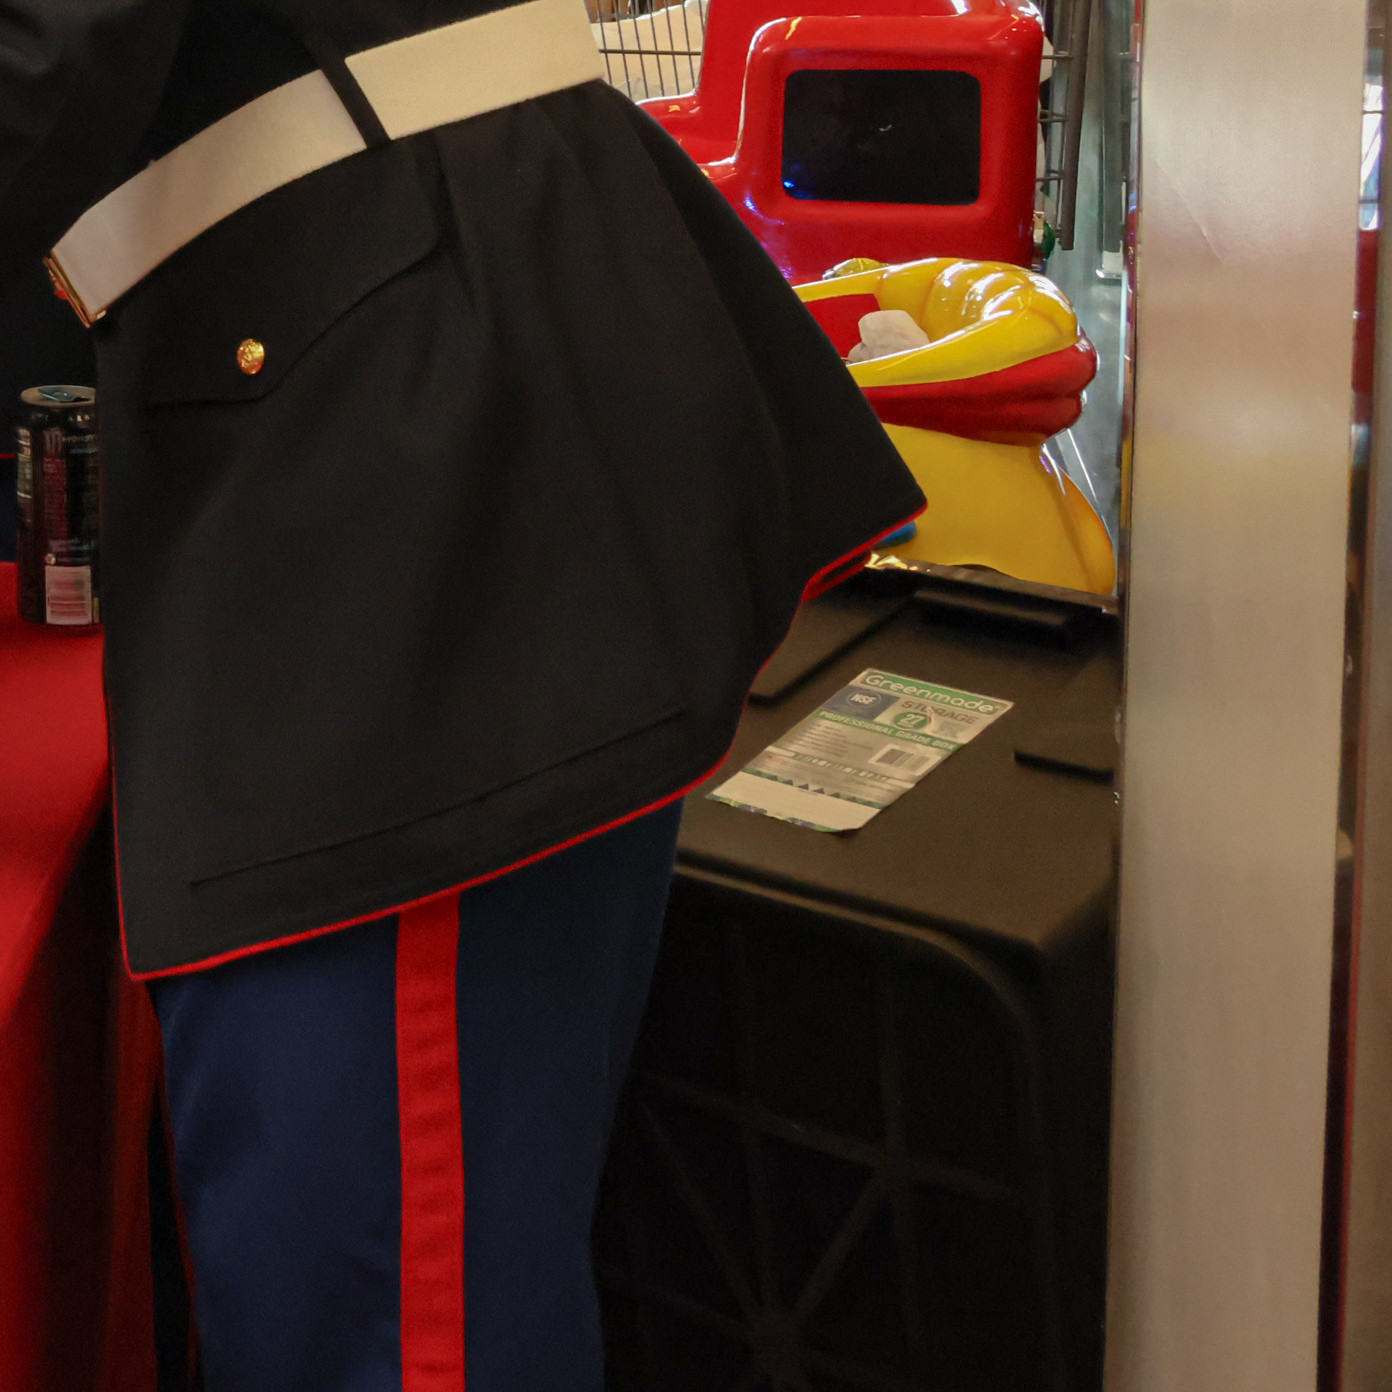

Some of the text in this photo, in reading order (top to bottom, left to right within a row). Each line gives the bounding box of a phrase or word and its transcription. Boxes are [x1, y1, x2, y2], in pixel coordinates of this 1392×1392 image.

[850, 692, 876, 706] NSF
[865, 674, 995, 714] Greenmade
[818, 710, 956, 751] PROFESSIONAL GRADE BOX
[905, 713, 925, 725] 27
